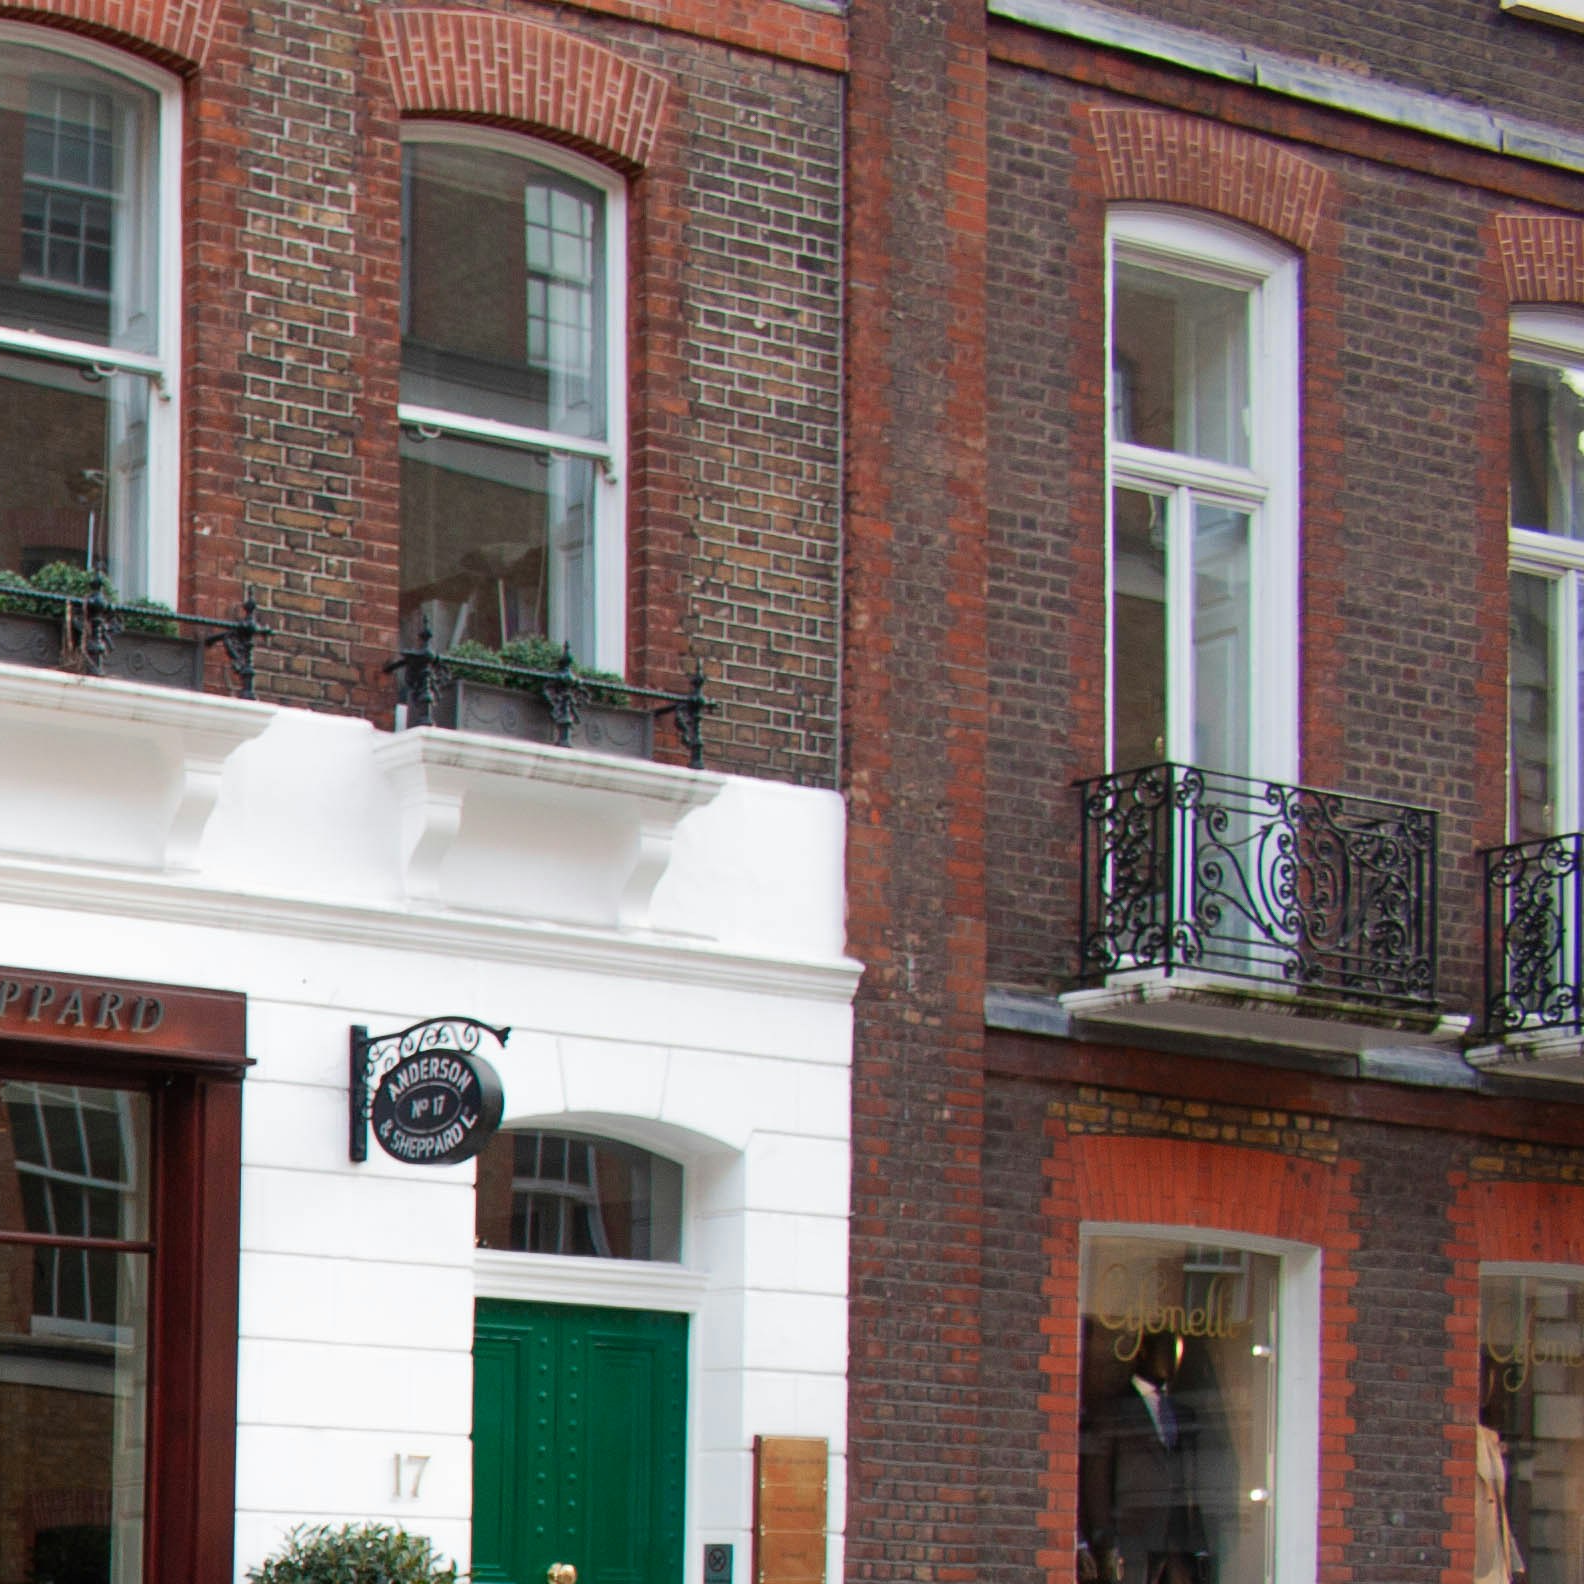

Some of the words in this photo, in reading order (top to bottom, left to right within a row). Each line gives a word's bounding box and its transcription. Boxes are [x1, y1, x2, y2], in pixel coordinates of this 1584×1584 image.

[388, 1057, 474, 1102] ANDERSON
[432, 1094, 446, 1116] 17
[380, 1118, 393, 1139] &
[390, 1123, 464, 1159] SHEPPARD
[393, 1453, 431, 1498] 17
